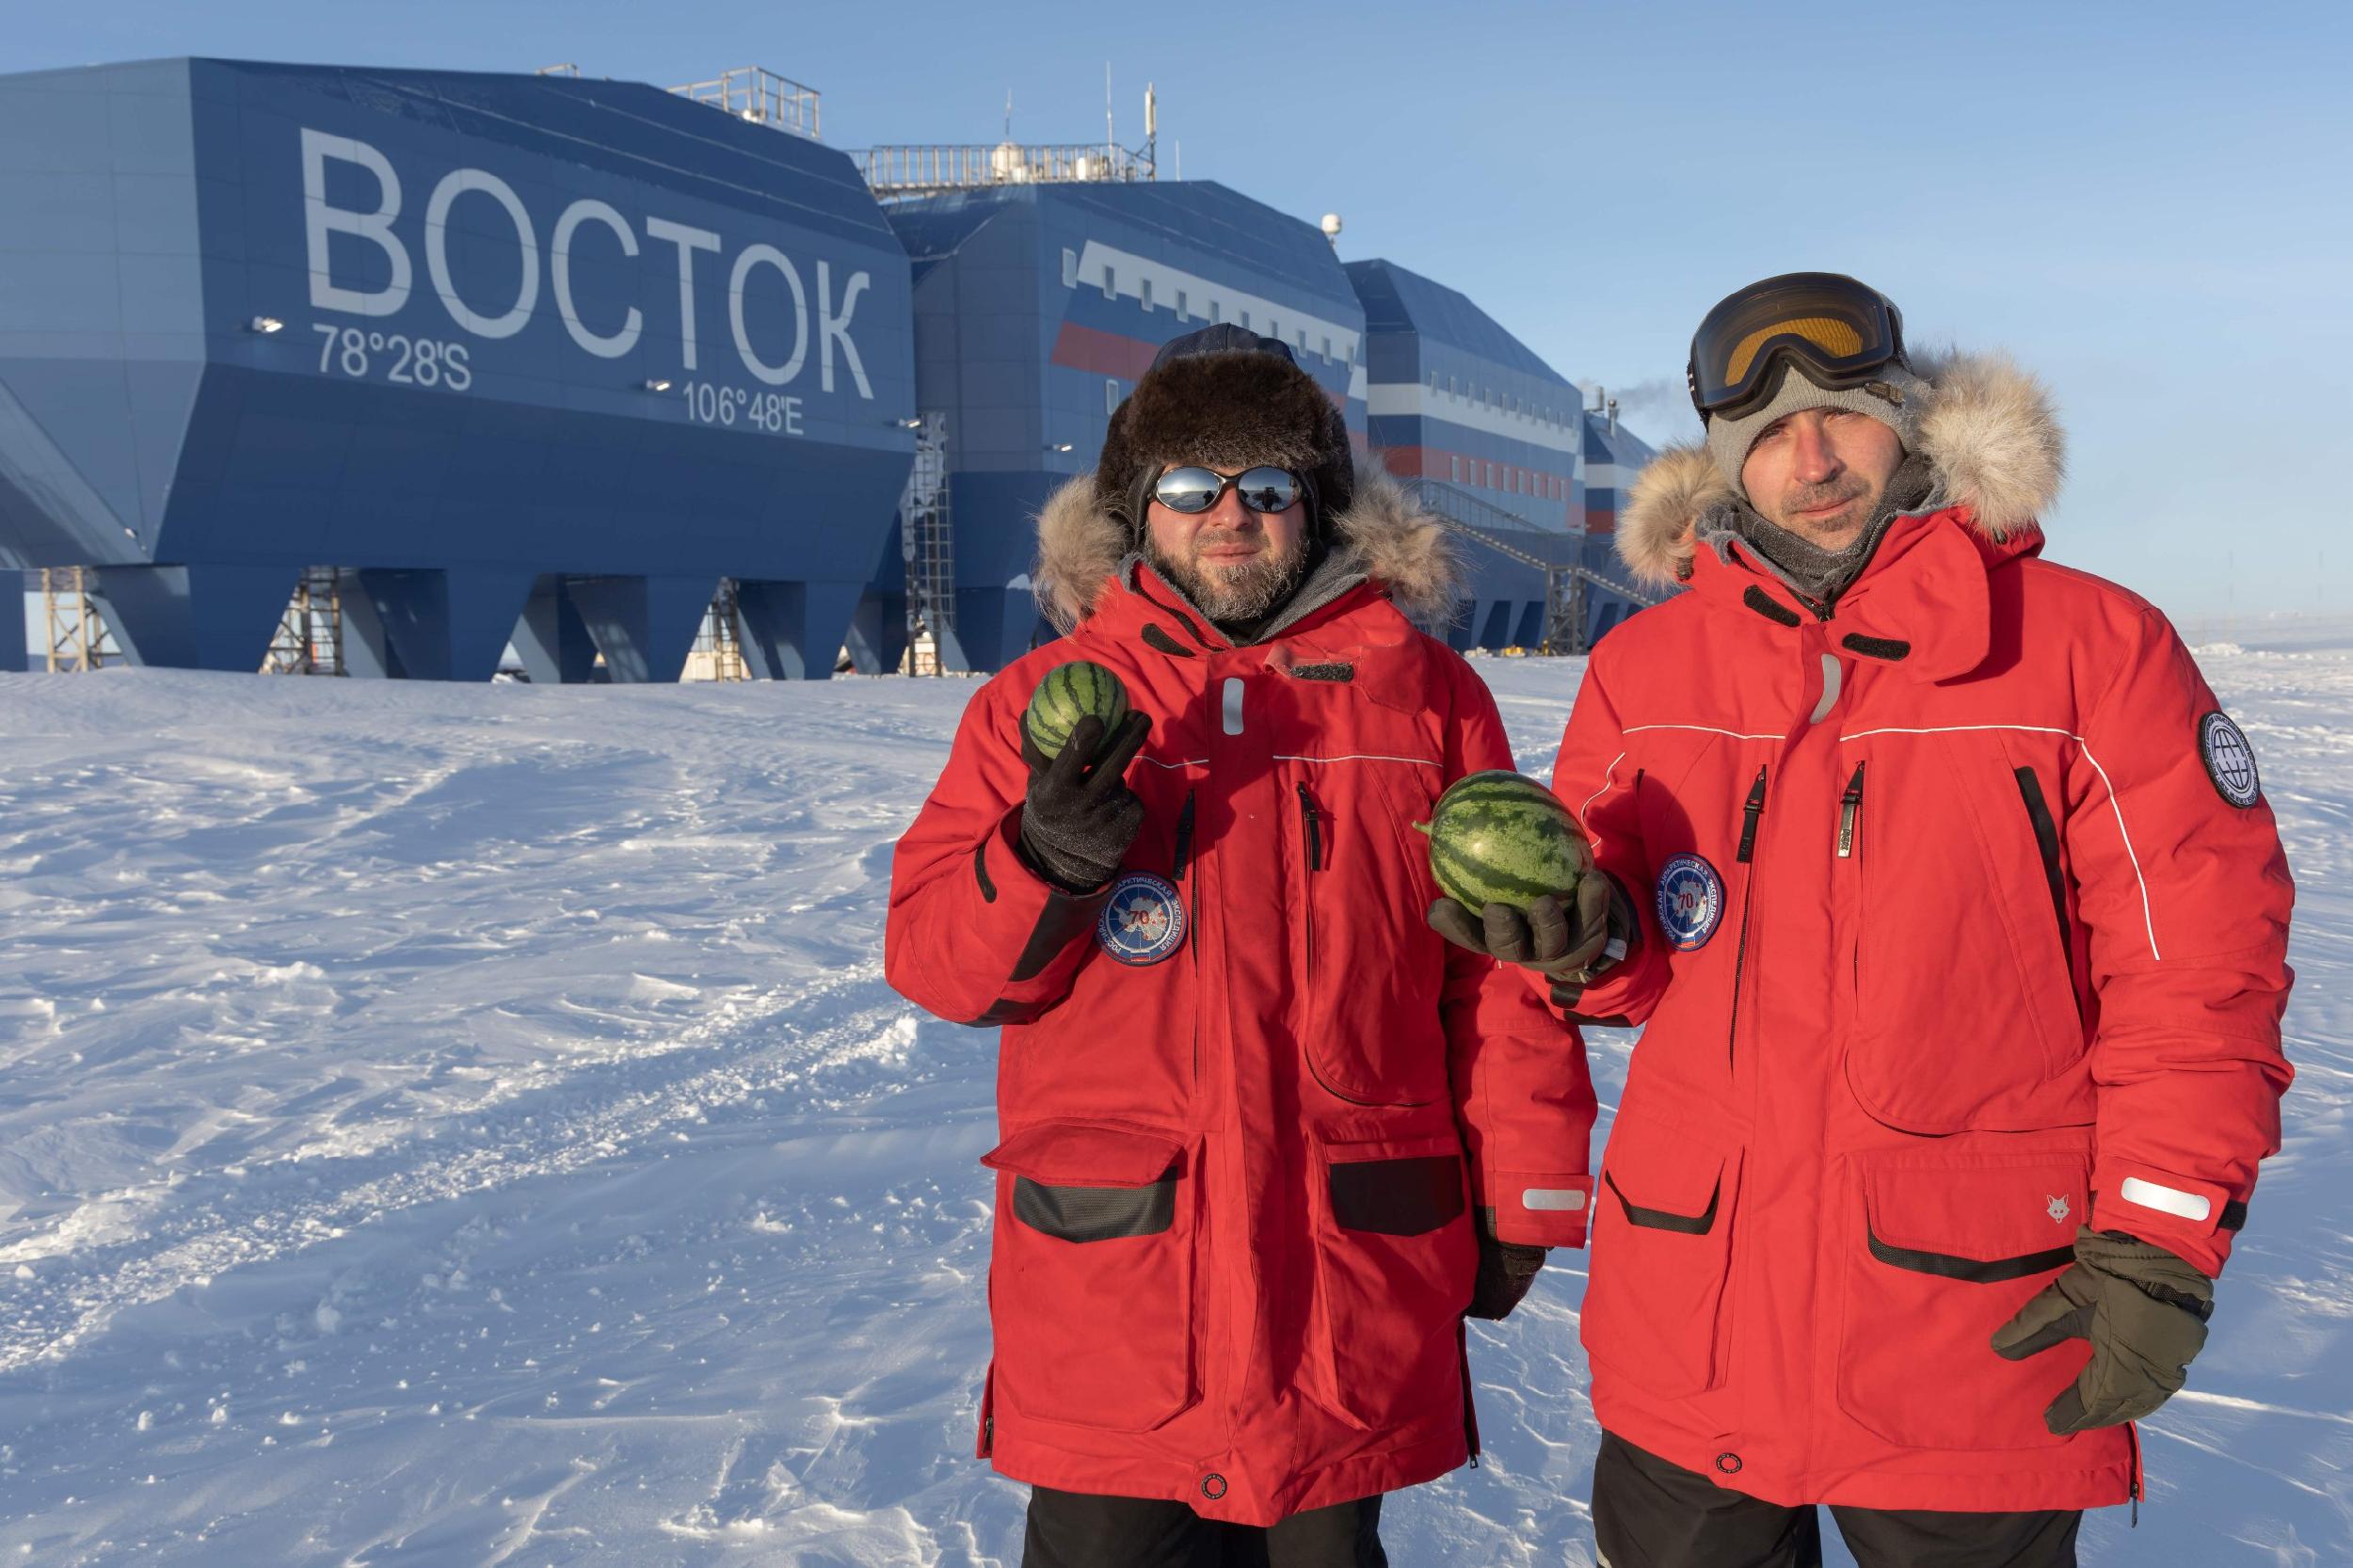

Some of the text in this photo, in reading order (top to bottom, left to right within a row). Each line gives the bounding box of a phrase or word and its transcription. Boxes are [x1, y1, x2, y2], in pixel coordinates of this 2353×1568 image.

[301, 128, 873, 399] ВОСТОК
[312, 323, 472, 392] 78°28'S
[1128, 910, 1150, 924] 70
[1679, 893, 1693, 910] 70
